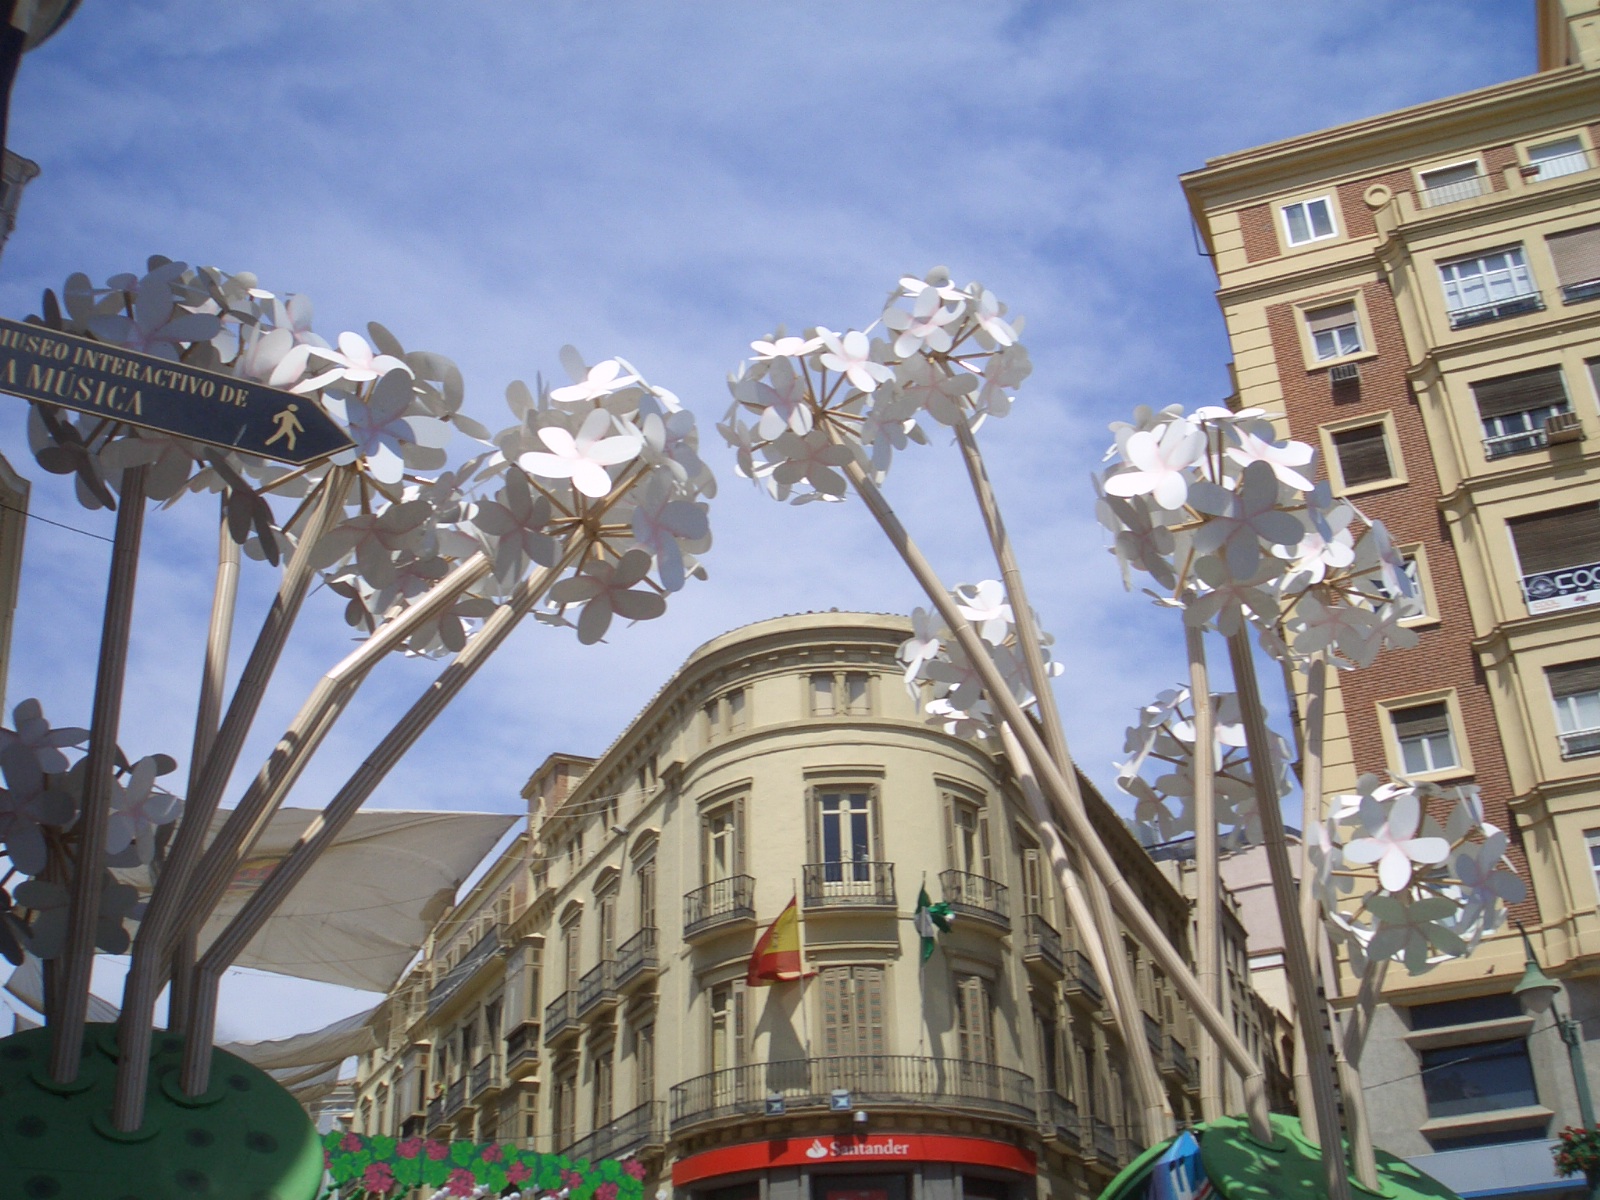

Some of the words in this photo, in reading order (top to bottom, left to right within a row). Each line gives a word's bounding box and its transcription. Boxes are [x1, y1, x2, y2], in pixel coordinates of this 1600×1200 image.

[26, 363, 142, 416] MÚSICA
[72, 346, 215, 398] INTERACTIVO
[219, 384, 249, 408] DE
[830, 1139, 909, 1157] Santander
